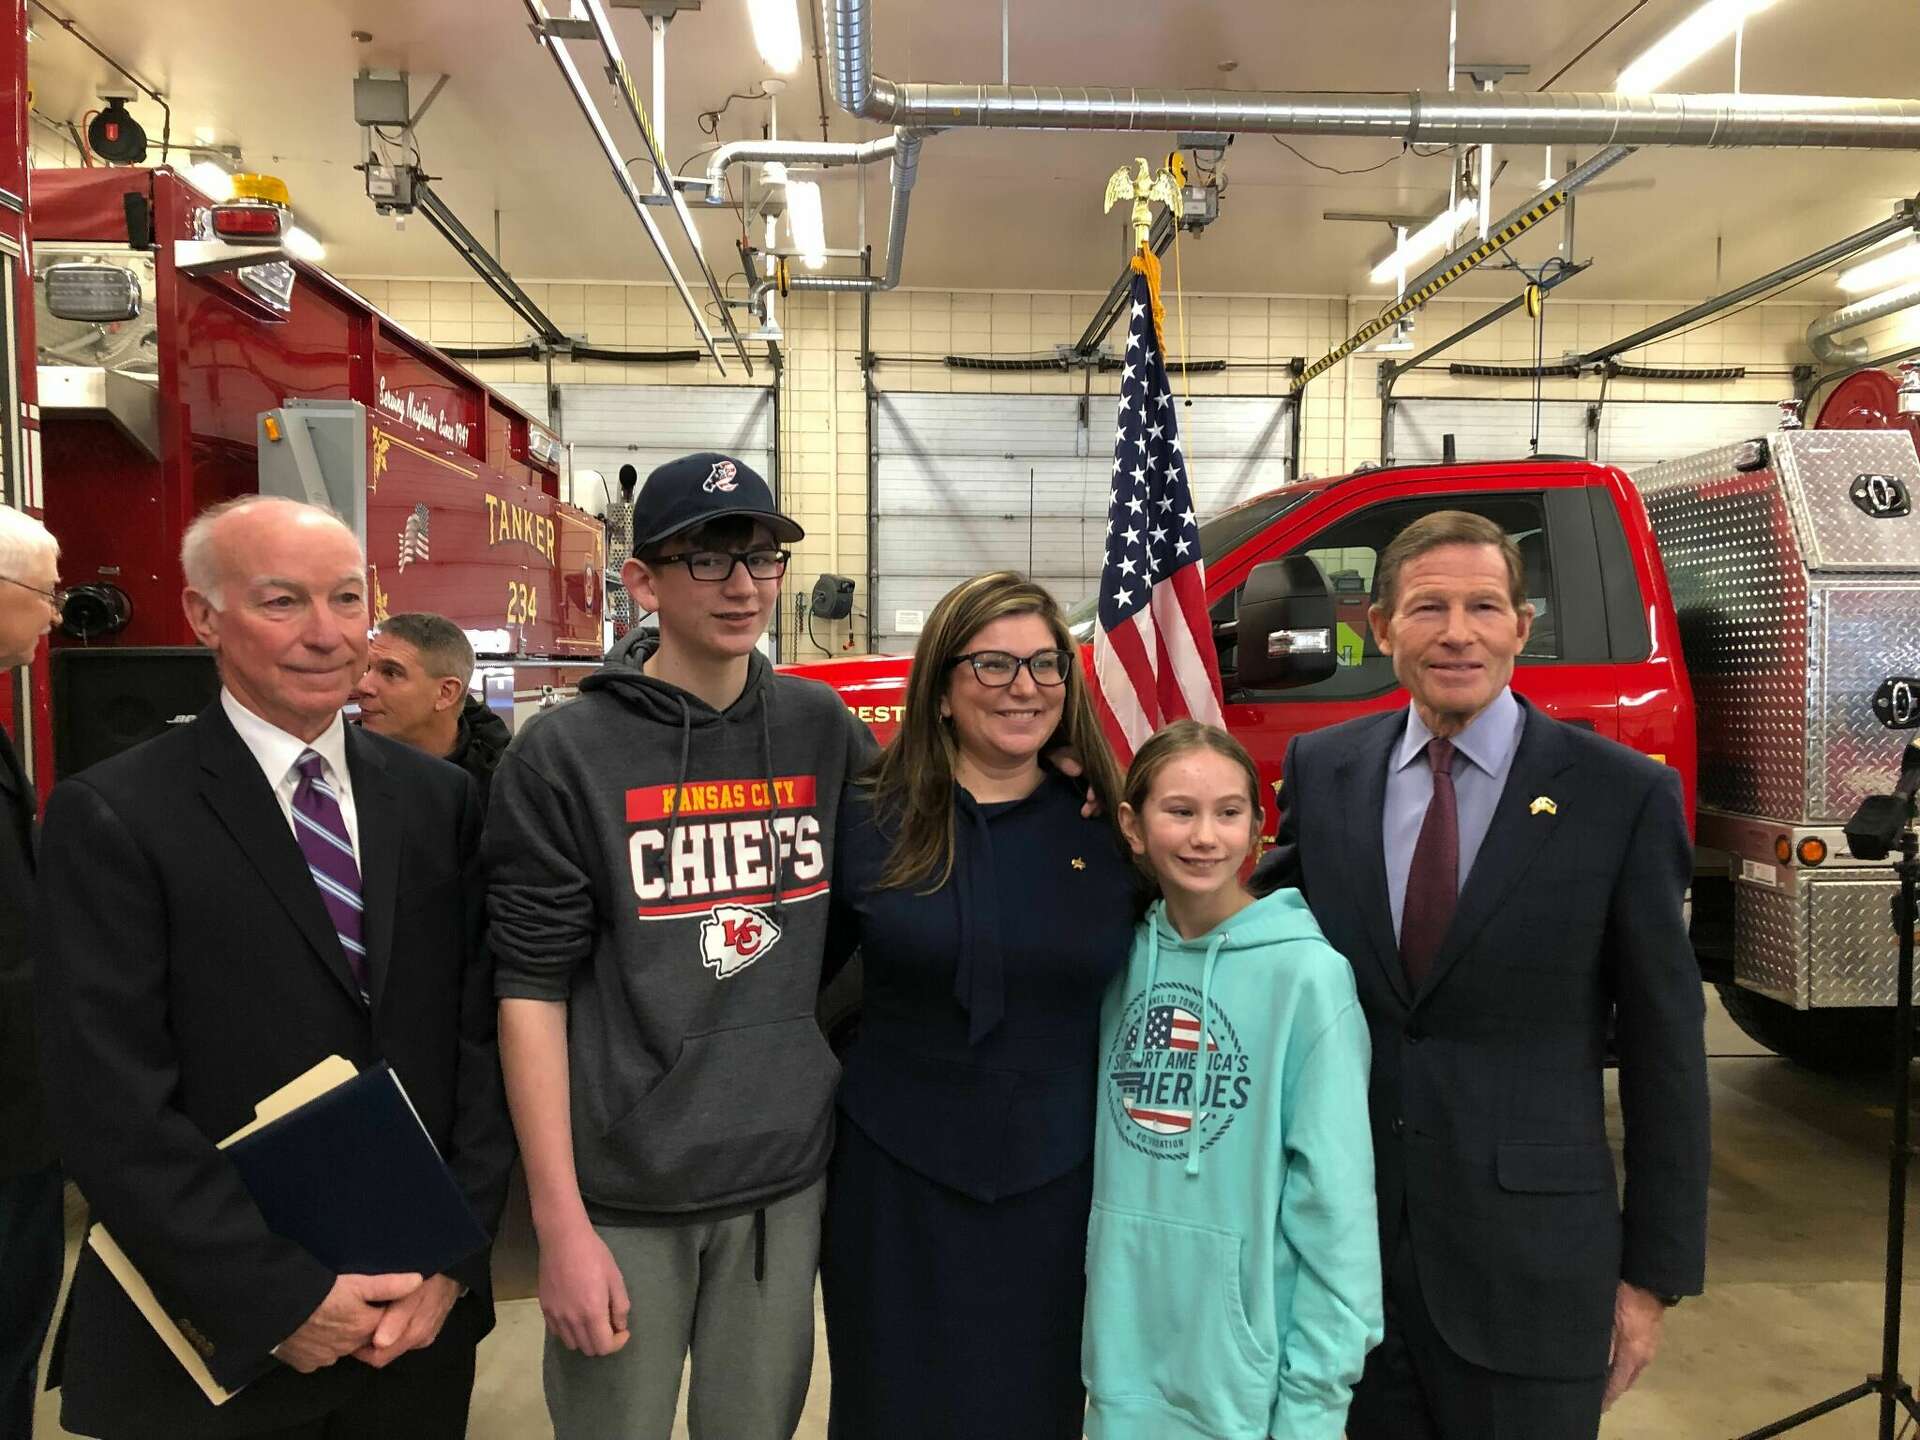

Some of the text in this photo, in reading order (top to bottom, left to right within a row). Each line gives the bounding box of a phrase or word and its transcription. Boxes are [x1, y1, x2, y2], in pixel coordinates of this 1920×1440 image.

[379, 375, 405, 423] Serving
[407, 391, 437, 432] Neighbors
[439, 409, 455, 441] Since
[485, 493, 555, 567] TANKER
[507, 581, 537, 626] 234
[662, 780, 795, 814] KANSAS CITY
[629, 815, 824, 899] CHIEFS
[722, 916, 762, 956] KC
[1164, 1051, 1249, 1074] AMEICA'S
